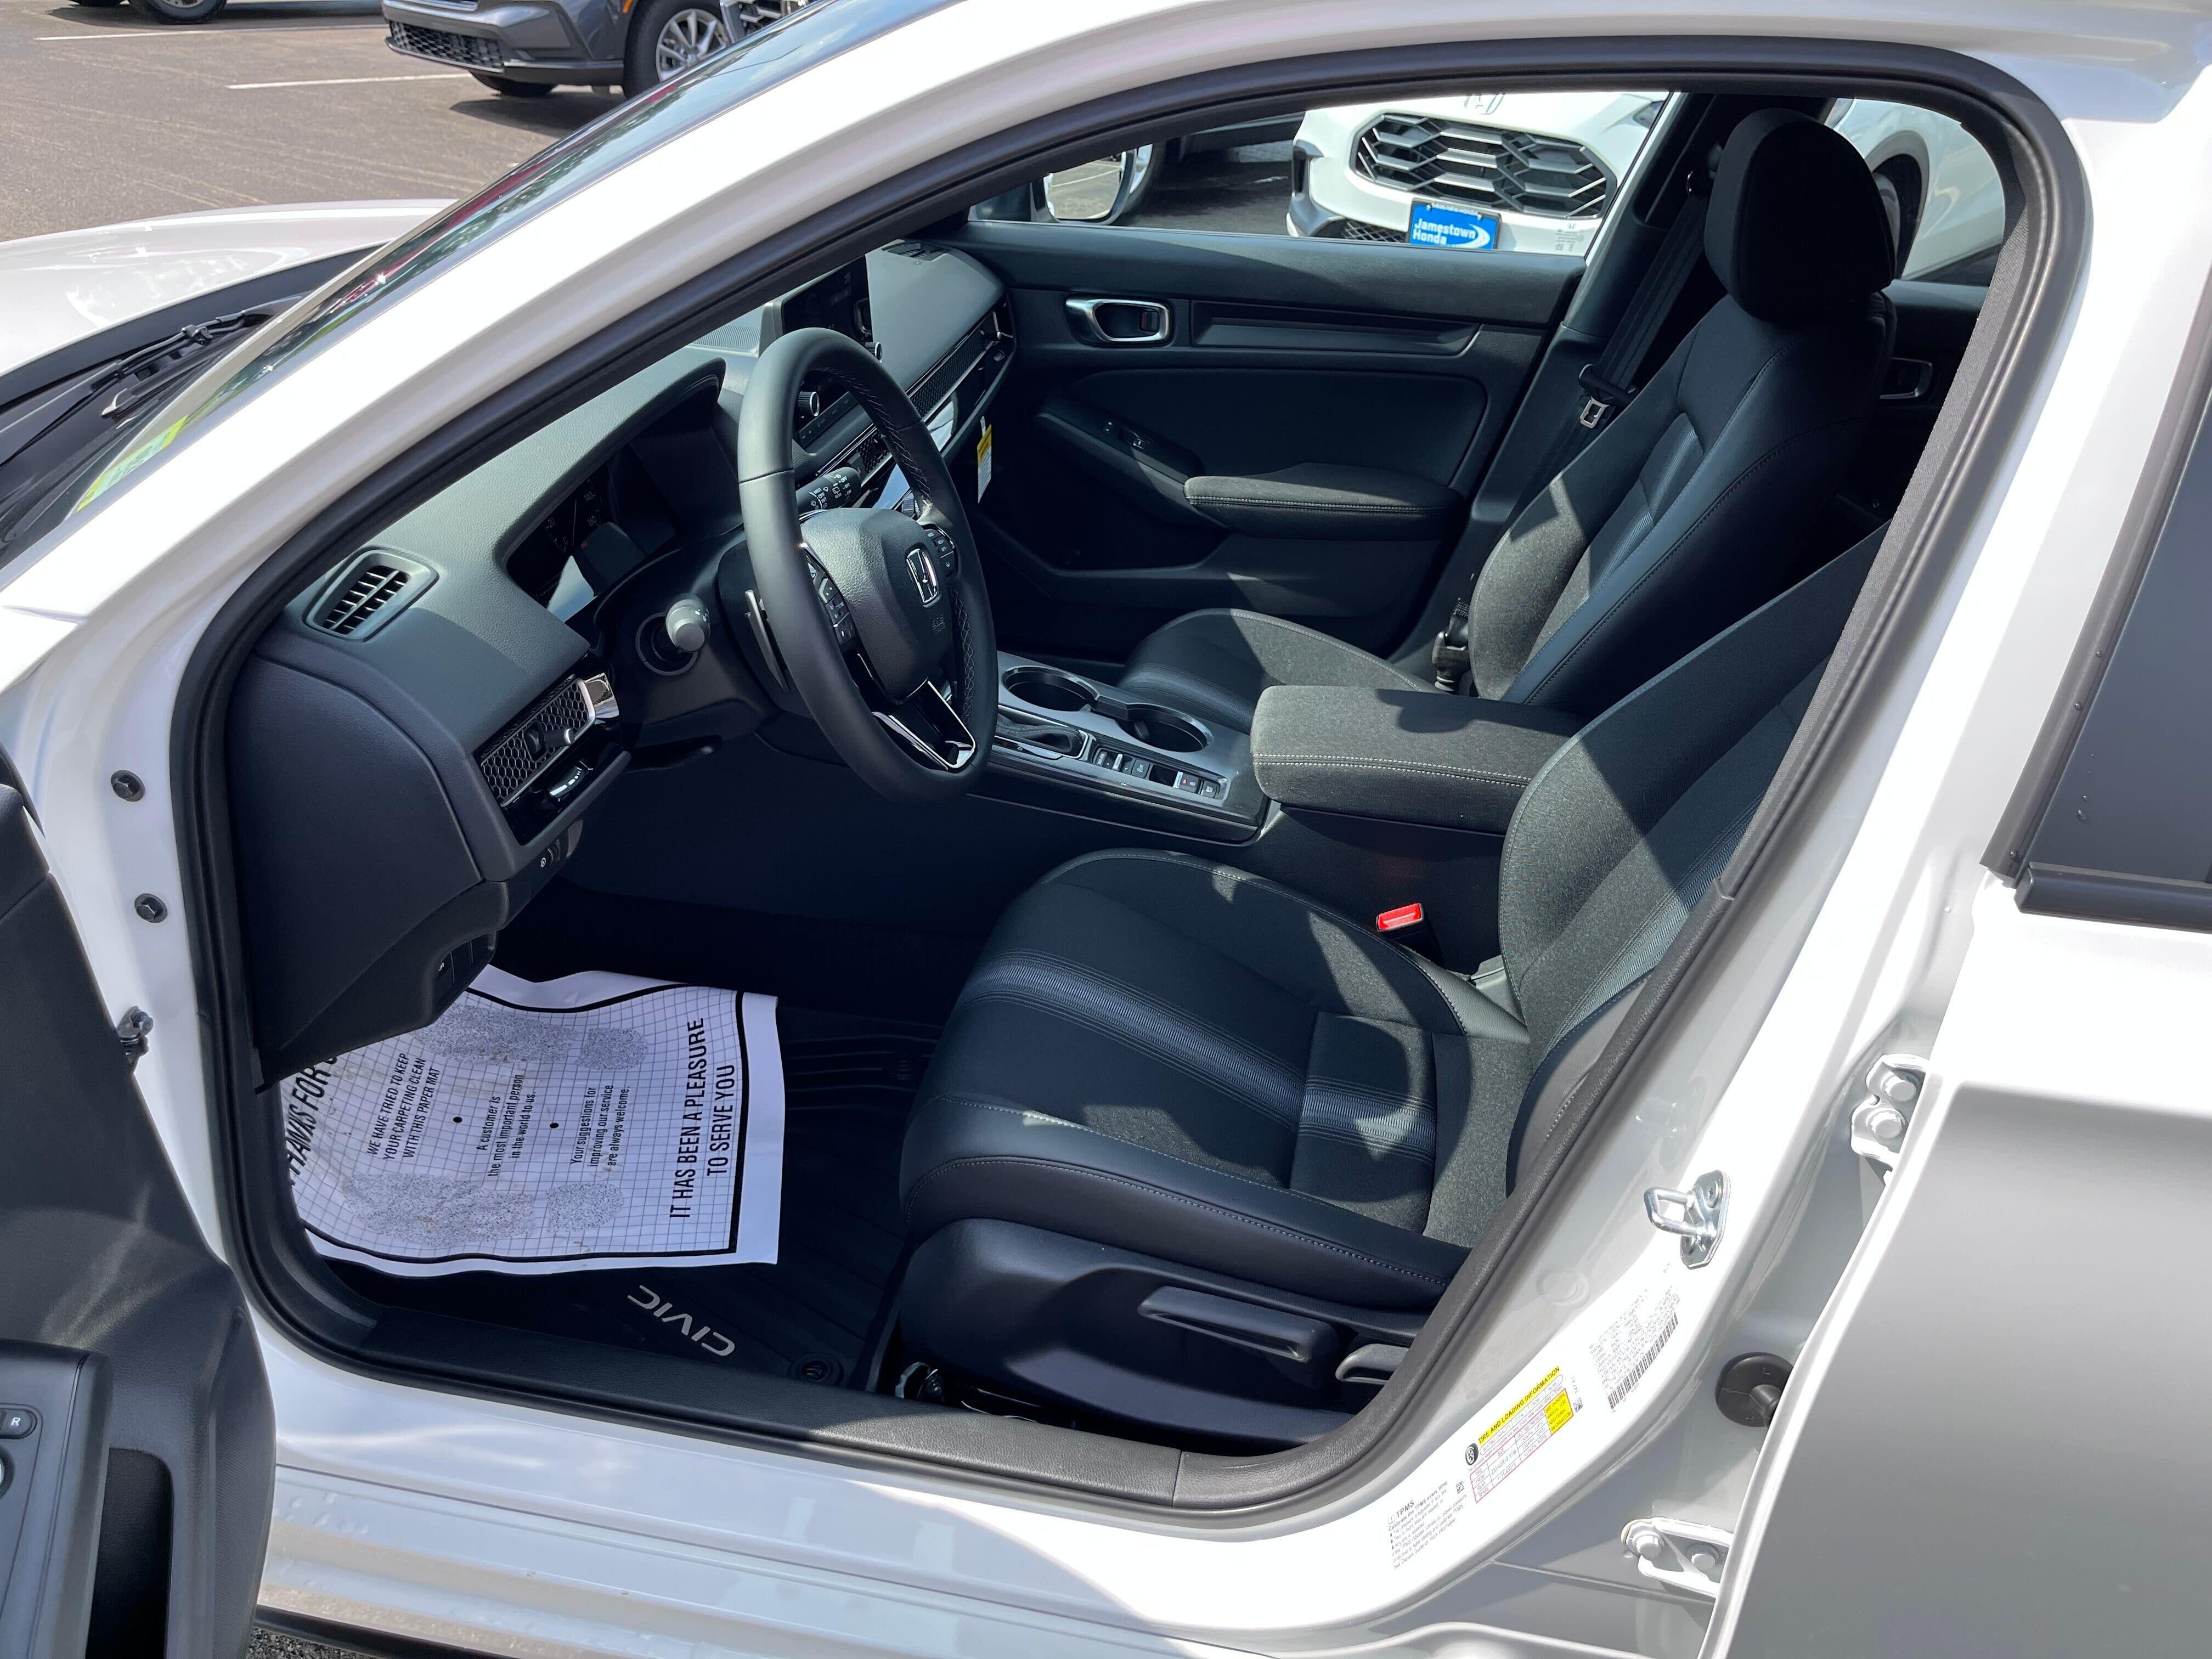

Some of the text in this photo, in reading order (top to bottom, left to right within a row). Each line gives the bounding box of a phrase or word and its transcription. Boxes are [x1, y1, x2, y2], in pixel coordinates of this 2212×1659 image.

[1413, 229, 1447, 245] Honda
[1414, 218, 1476, 239] Jamestown
[285, 1066, 331, 1186] HANKS FOR
[367, 1053, 410, 1155] WE HAVE TRIED TO KEEP
[383, 1058, 426, 1160] YOUR CARPETING CLEAN
[402, 1066, 440, 1158] WITH THIS PAPER MAT
[482, 1105, 498, 1143] customer
[488, 1074, 523, 1176] the most important person
[517, 1114, 531, 1135] world
[522, 1104, 532, 1114] to
[571, 1087, 597, 1165] Your suggestions for
[588, 1085, 613, 1167] improving our service
[609, 1124, 624, 1151] always
[669, 1018, 707, 1218] IT HAS BEEN A PLEASURE
[707, 1064, 736, 1176] TO SERVE YOU
[511, 1133, 524, 1149] the
[607, 1153, 618, 1166] are
[627, 1285, 735, 1356] CIVIC
[10, 1417, 21, 1426] R
[1478, 1431, 1490, 1444] TIRE
[1490, 1421, 1501, 1434] AND
[1501, 1399, 1525, 1423] LOADING
[1525, 1365, 1560, 1402] INFORMATION
[1396, 1500, 1414, 1518] TPMS
